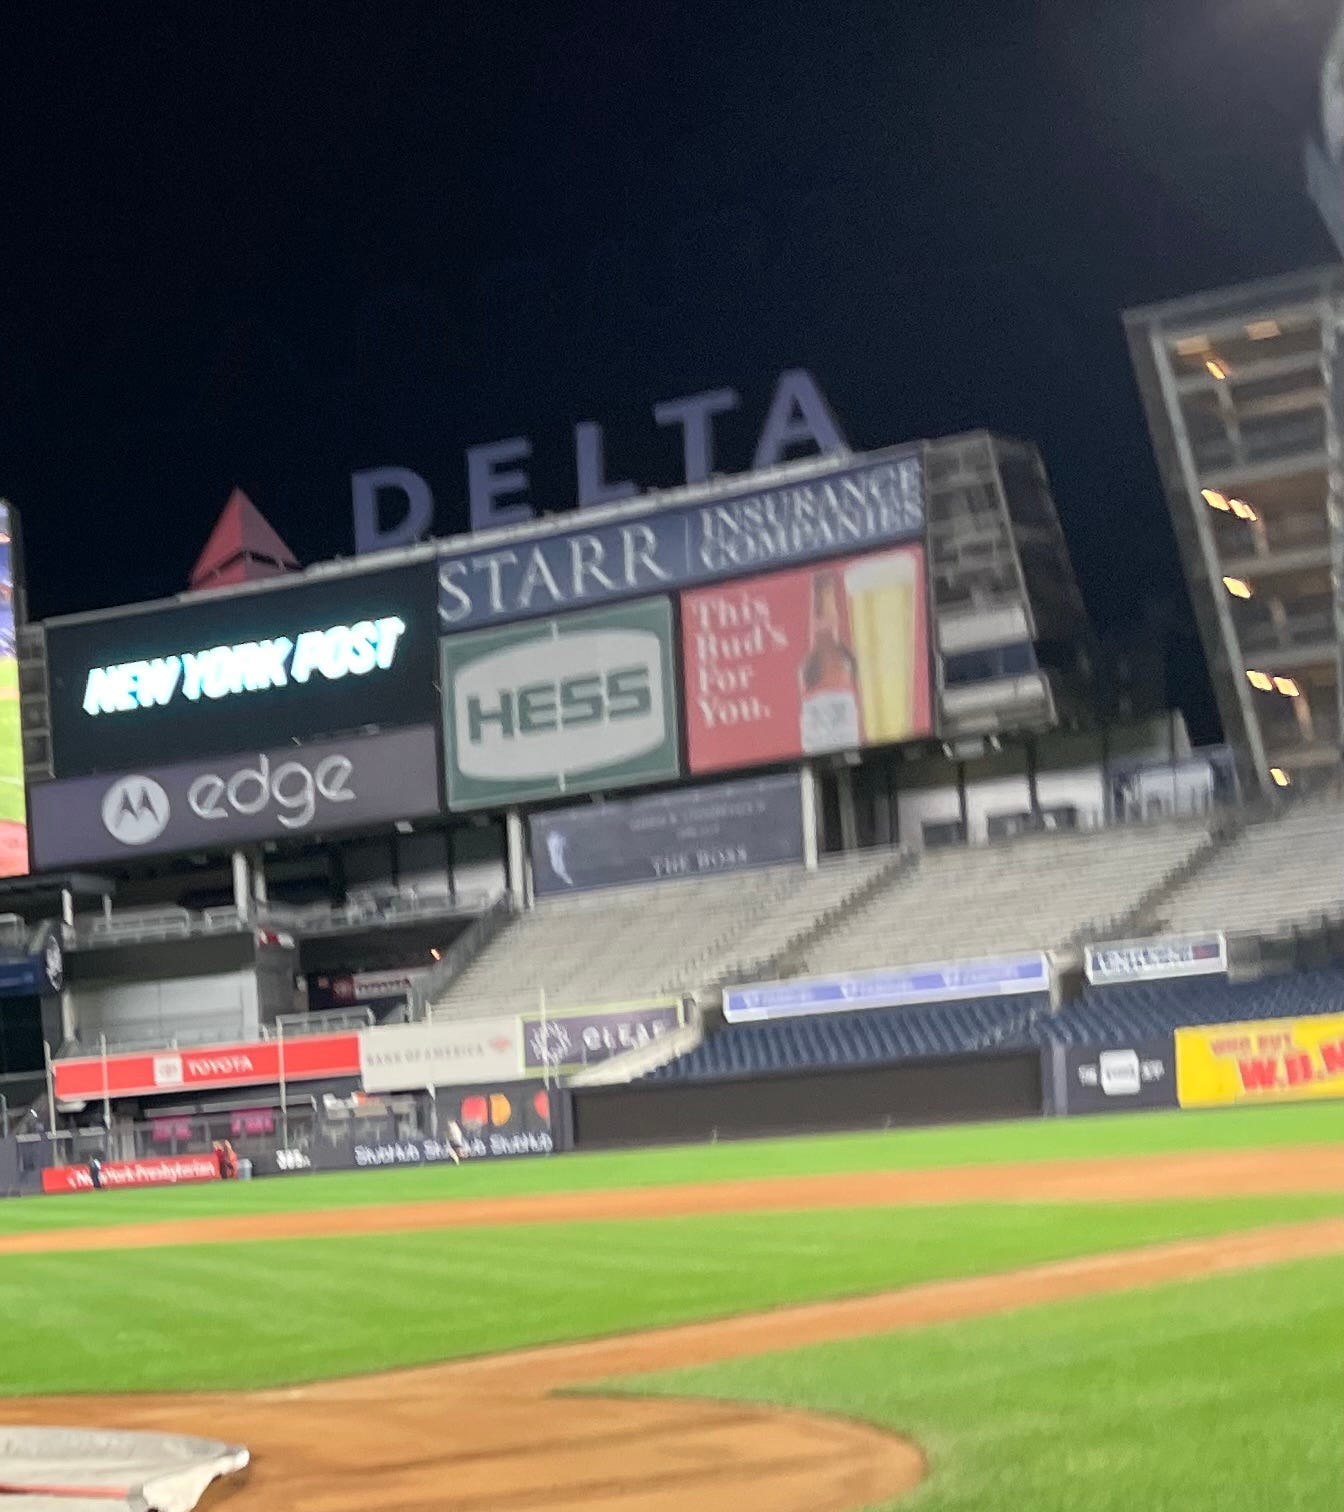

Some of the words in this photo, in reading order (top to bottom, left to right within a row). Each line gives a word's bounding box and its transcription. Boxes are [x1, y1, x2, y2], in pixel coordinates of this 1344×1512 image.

[350, 367, 853, 555] DELTA
[437, 520, 674, 624] STARR
[83, 656, 182, 715] NEW
[181, 635, 294, 700] YORK
[290, 615, 406, 683] POST
[468, 665, 652, 747] HESS
[188, 754, 356, 829] edge
